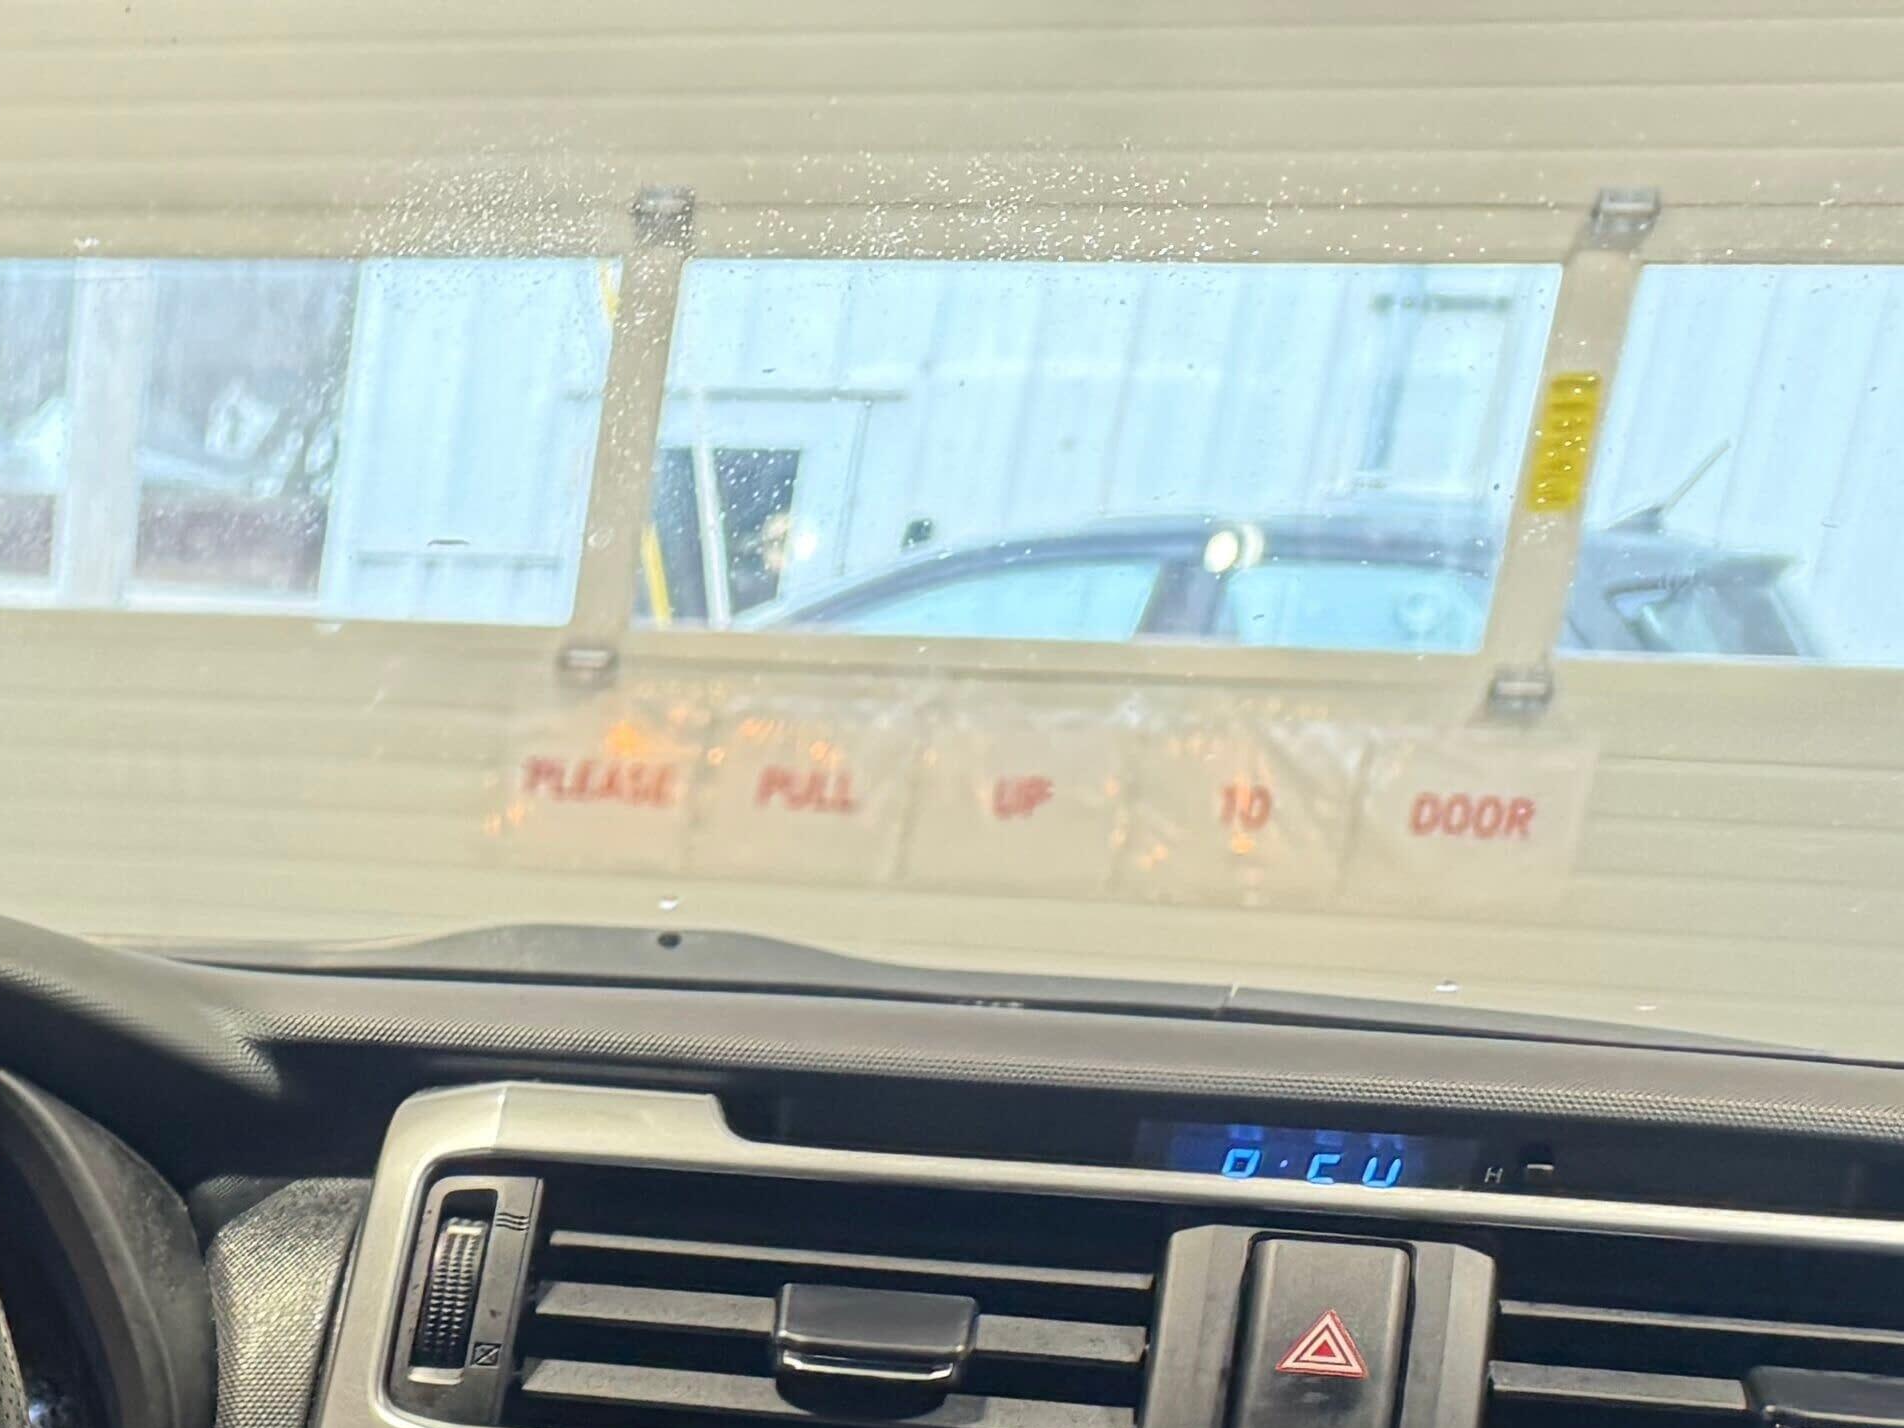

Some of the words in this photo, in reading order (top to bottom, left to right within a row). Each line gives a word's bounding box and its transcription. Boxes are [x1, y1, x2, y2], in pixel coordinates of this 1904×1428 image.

[522, 756, 677, 808] PLEASE
[755, 763, 858, 816] PULL
[990, 774, 1054, 821] UP
[1409, 791, 1537, 842] DOOR
